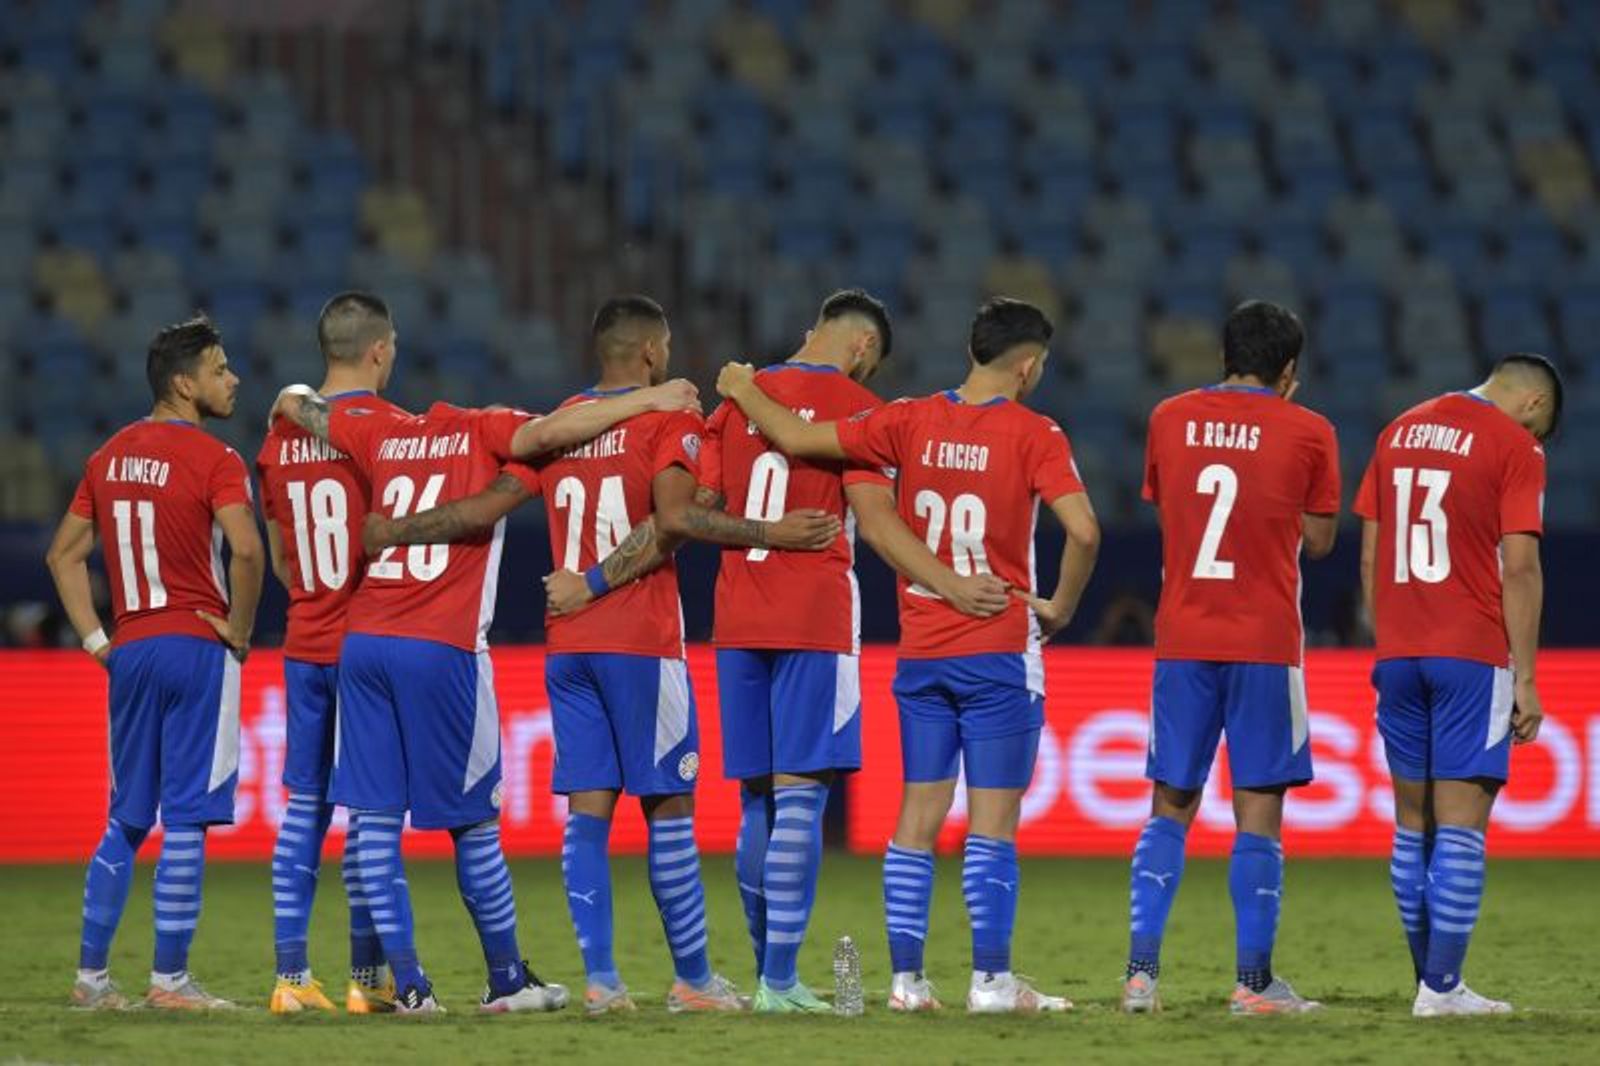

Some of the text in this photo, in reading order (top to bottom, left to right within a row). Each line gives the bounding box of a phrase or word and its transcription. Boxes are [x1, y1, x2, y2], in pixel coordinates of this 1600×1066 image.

[120, 455, 170, 488] ROMERO
[921, 439, 989, 472] J. ENCISO
[1186, 421, 1261, 451] R. ROJAS
[1404, 423, 1474, 457] ESPINOLA
[113, 500, 167, 611] 11
[288, 480, 349, 592] 18
[368, 473, 449, 582] 26
[745, 451, 789, 562] 9
[1192, 464, 1238, 579] 2
[1393, 467, 1451, 583] 13
